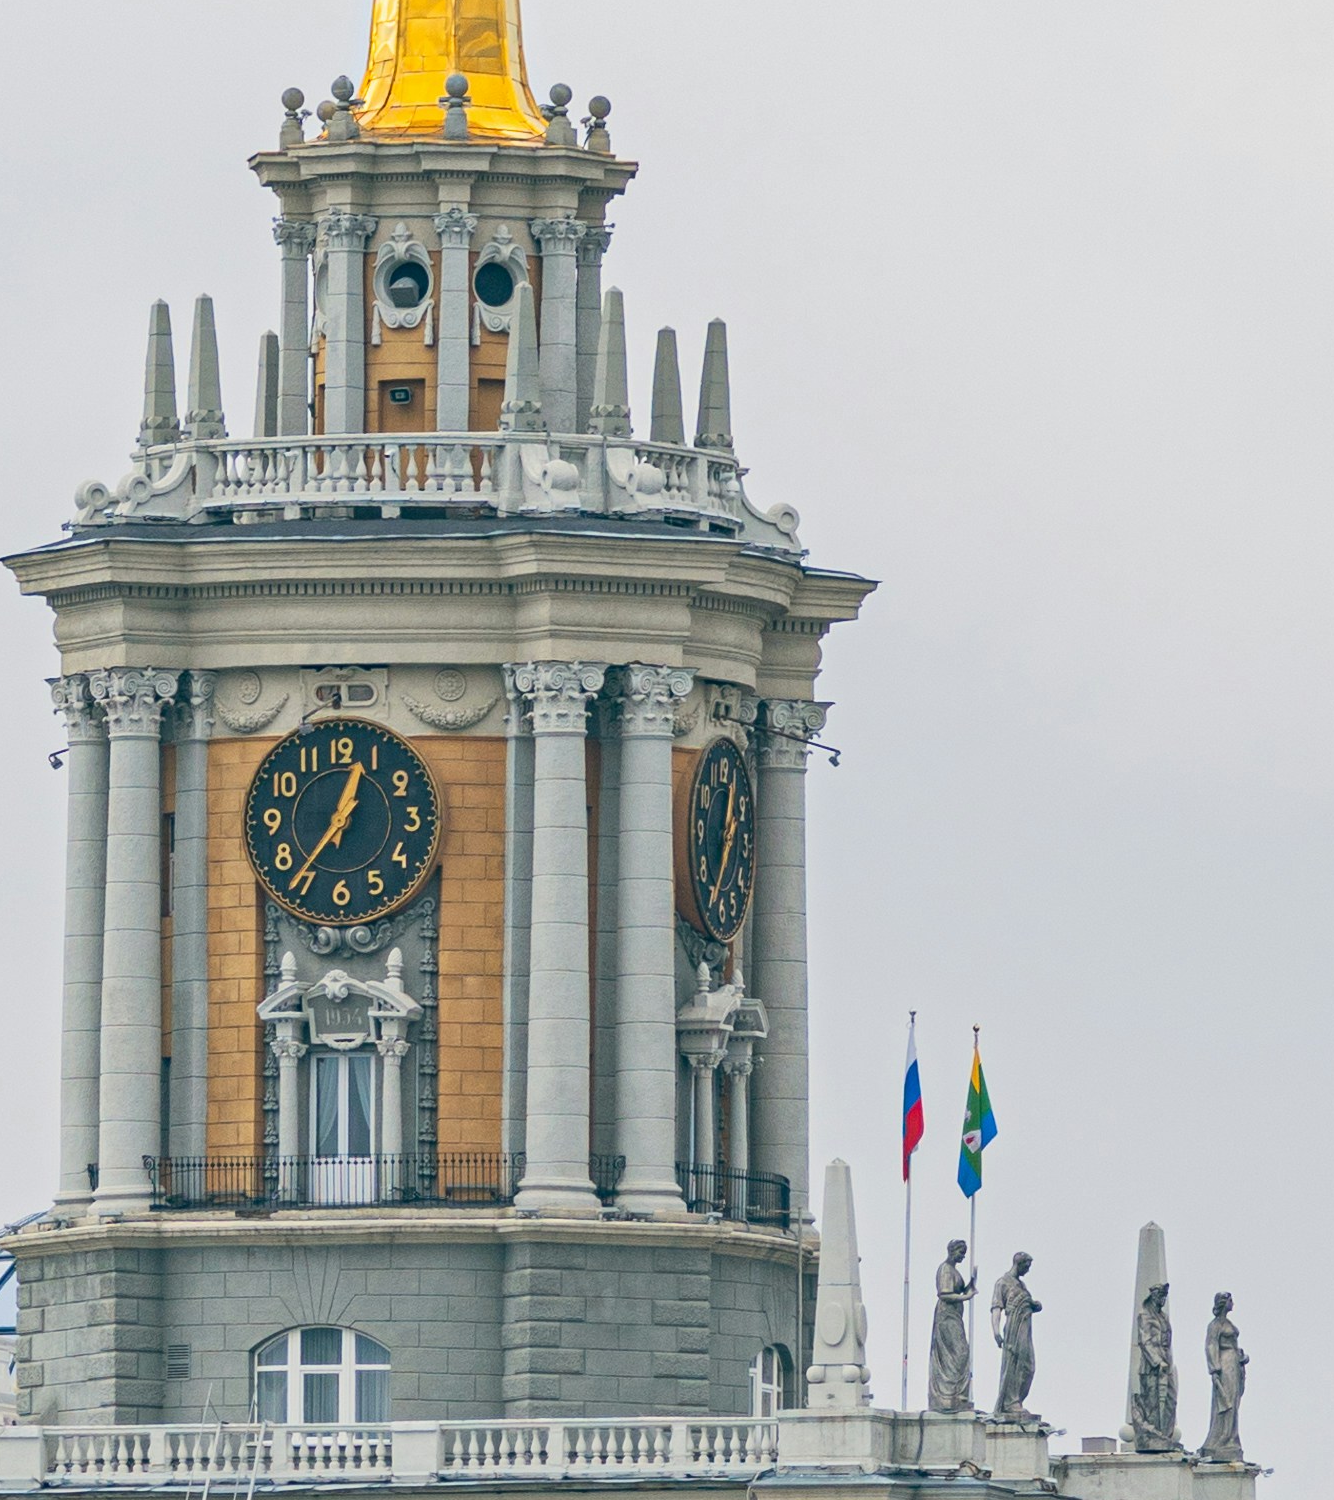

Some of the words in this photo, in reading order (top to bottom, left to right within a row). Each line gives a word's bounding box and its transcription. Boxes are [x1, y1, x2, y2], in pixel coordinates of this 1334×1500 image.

[300, 746, 318, 772] 11
[330, 737, 354, 764] 12
[371, 745, 378, 771] 1
[392, 770, 409, 796] 2
[710, 762, 718, 788] 11
[719, 757, 729, 784] 12
[273, 771, 297, 797] 10
[700, 783, 710, 810] 10
[403, 806, 421, 832] 3
[739, 796, 746, 821] 2
[263, 808, 282, 836] 9
[697, 819, 704, 845] 9
[274, 843, 293, 871] 8
[391, 842, 407, 869] 4
[743, 833, 749, 859] 3
[699, 855, 708, 883] 8
[737, 867, 744, 894] 4
[299, 871, 317, 896] 7
[332, 879, 351, 906] 6
[367, 870, 384, 895] 5
[719, 898, 726, 924] 6
[730, 892, 737, 917] 5
